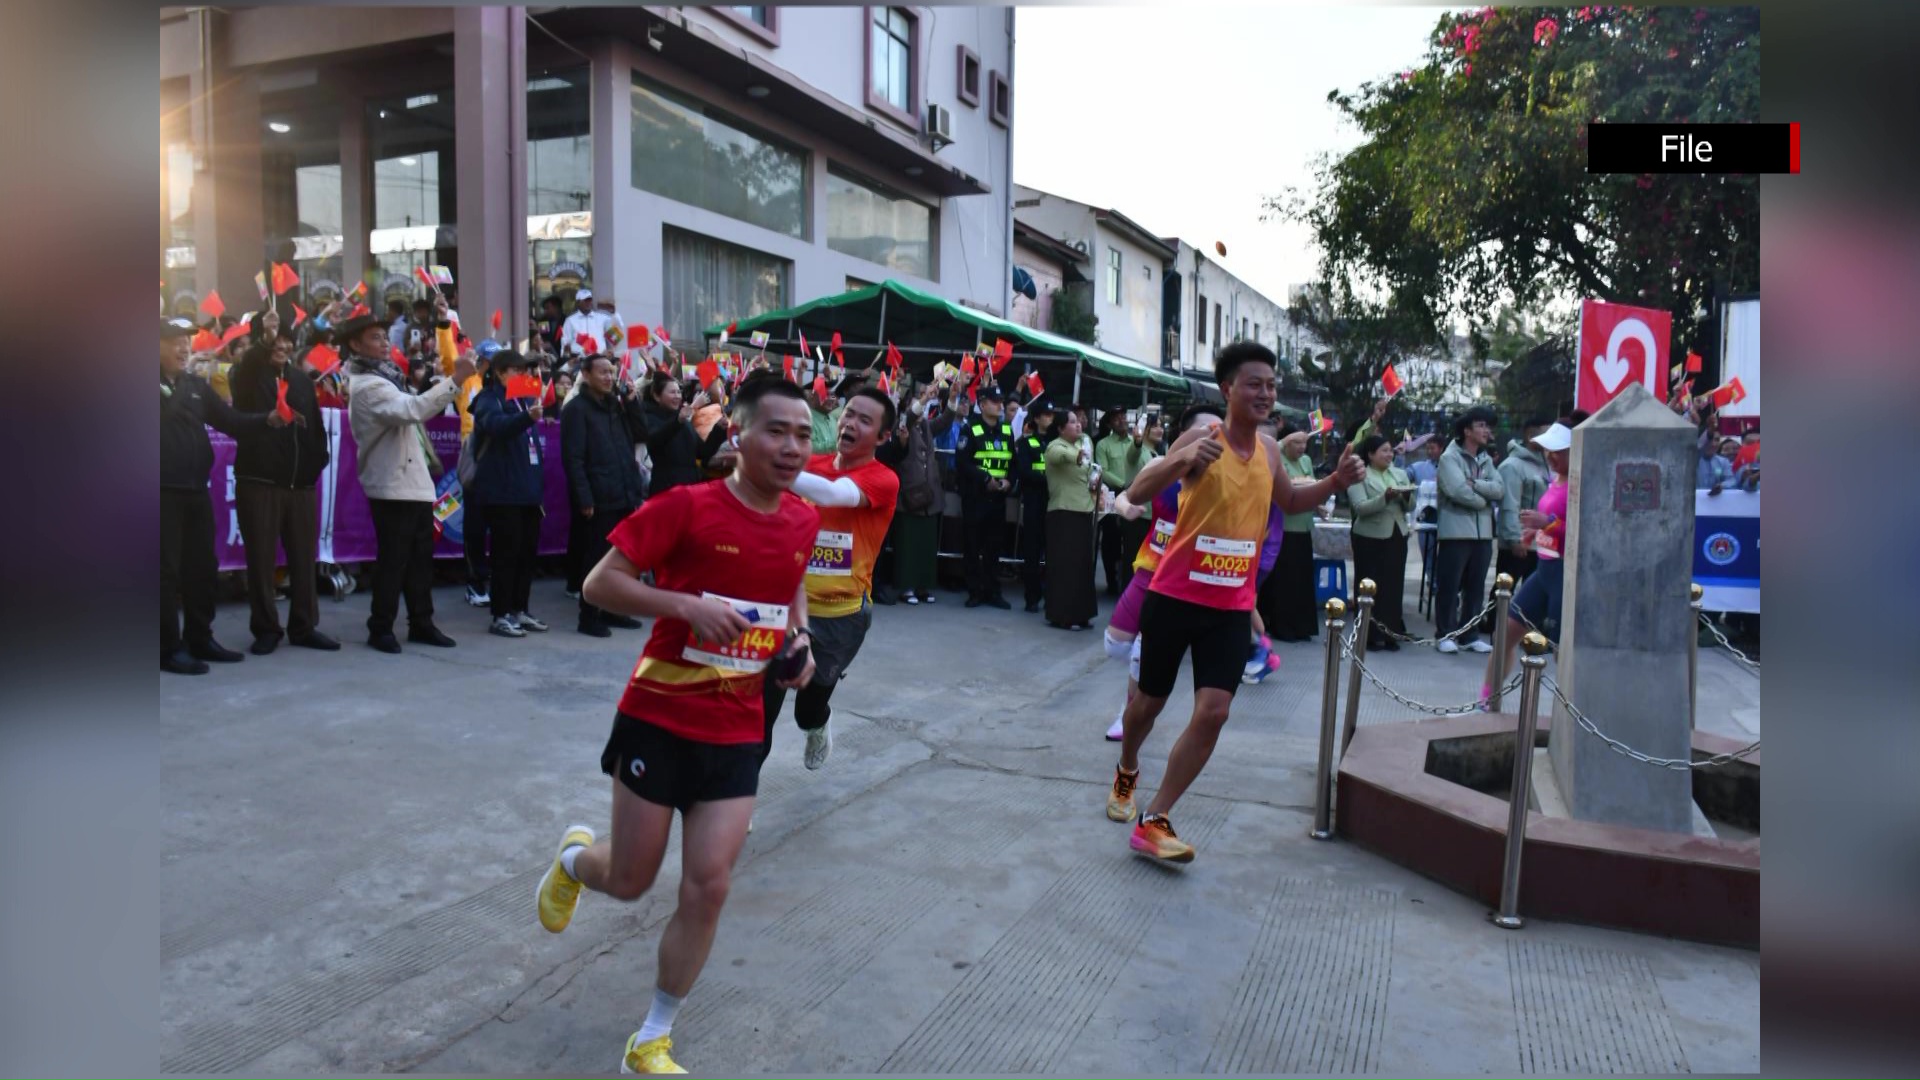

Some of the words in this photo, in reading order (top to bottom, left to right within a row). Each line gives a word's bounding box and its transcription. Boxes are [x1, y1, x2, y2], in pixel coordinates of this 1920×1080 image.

[983, 458, 1009, 469] NIA
[811, 547, 844, 563] 983
[1199, 553, 1251, 573] A0023
